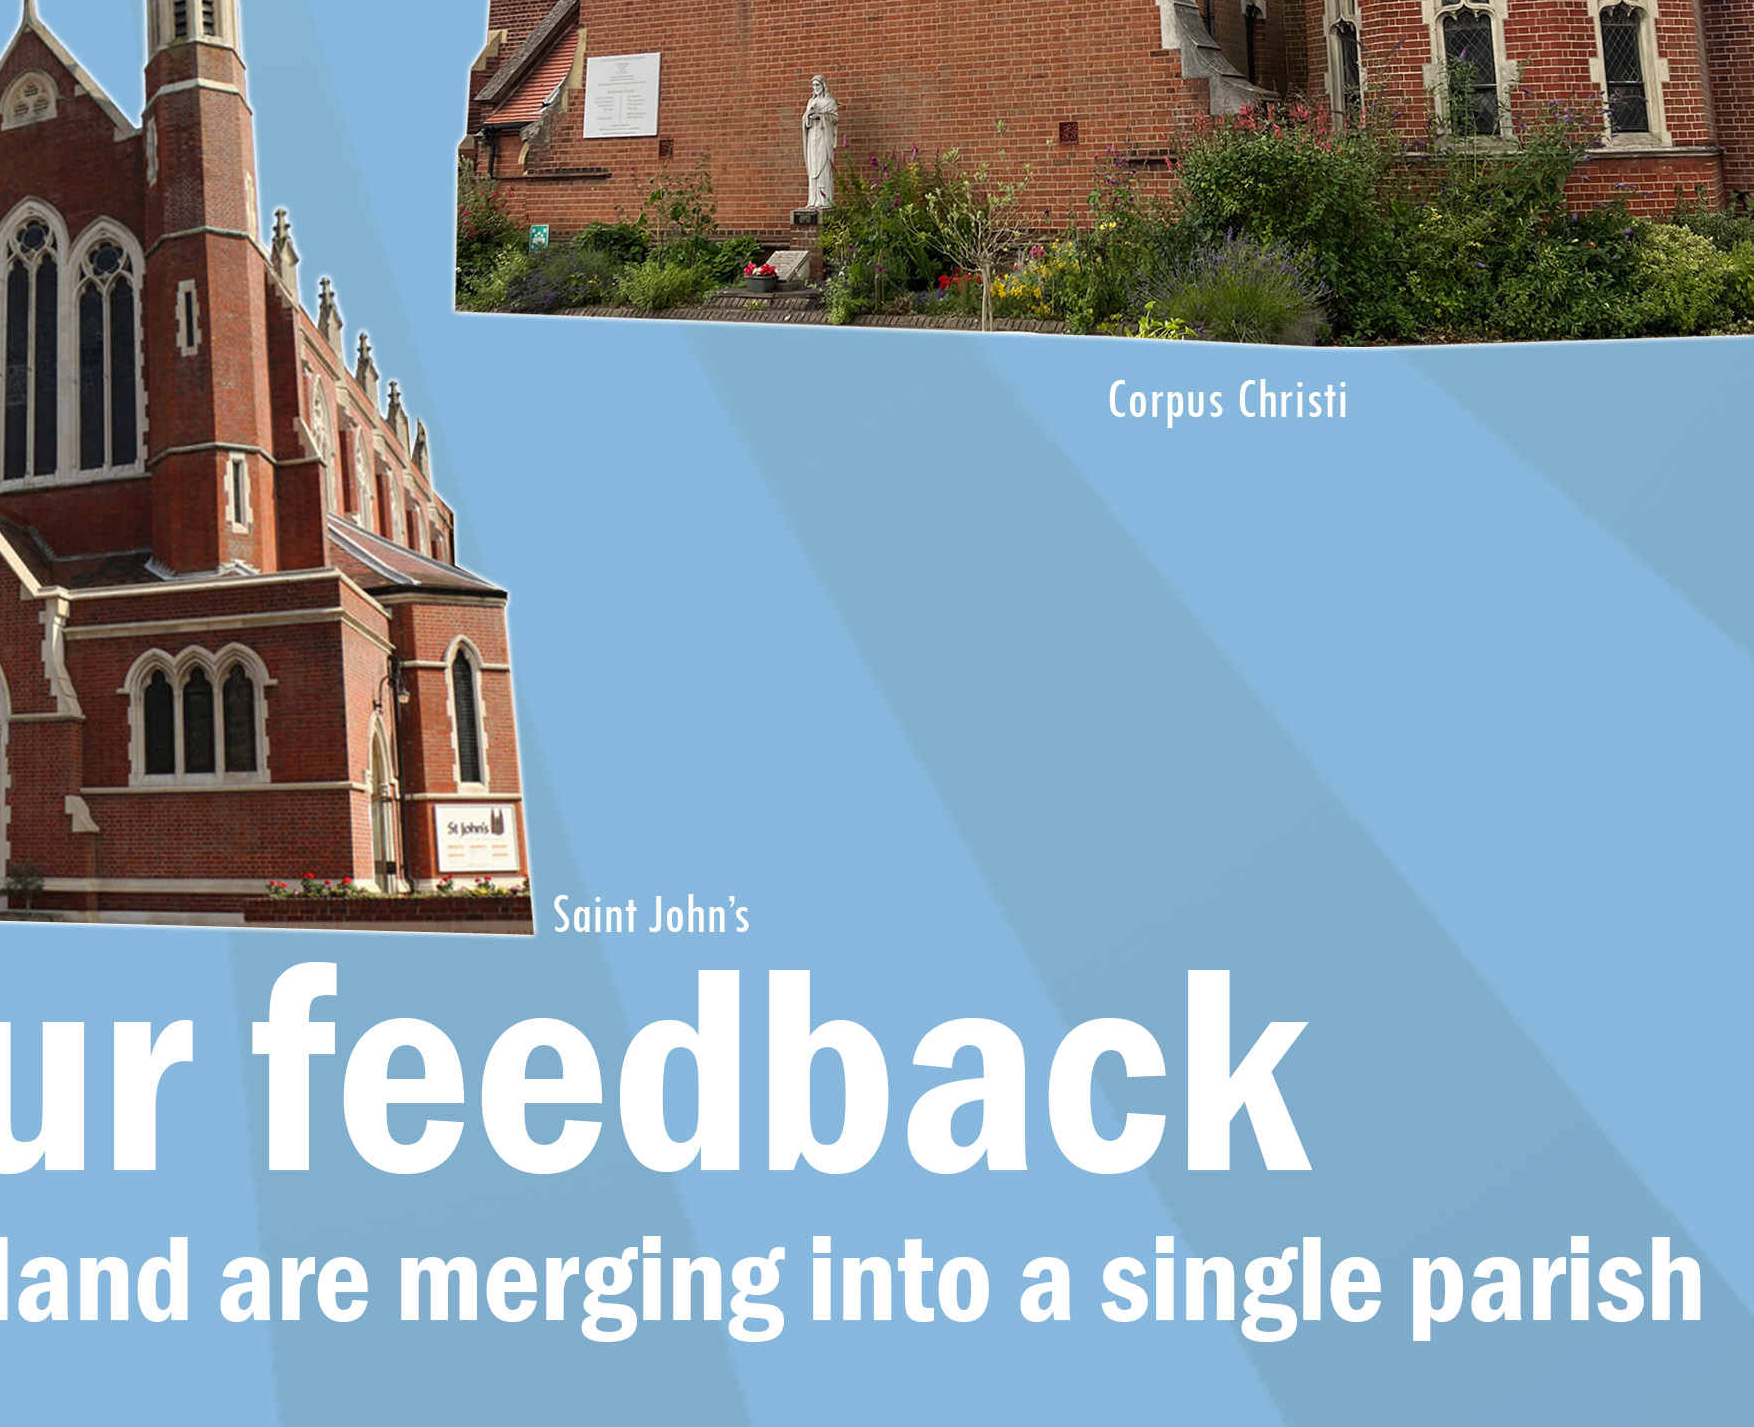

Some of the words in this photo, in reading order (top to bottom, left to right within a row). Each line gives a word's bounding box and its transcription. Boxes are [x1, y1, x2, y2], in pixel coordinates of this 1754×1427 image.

[447, 821, 459, 835] St
[460, 822, 490, 838] John's
[251, 960, 1314, 1176] feedback
[219, 1255, 369, 1324] are
[400, 1234, 787, 1344] merging
[811, 1234, 991, 1324] into
[1019, 1255, 1072, 1324] a
[1100, 1234, 1382, 1344] single
[1412, 1234, 1702, 1343] parish
